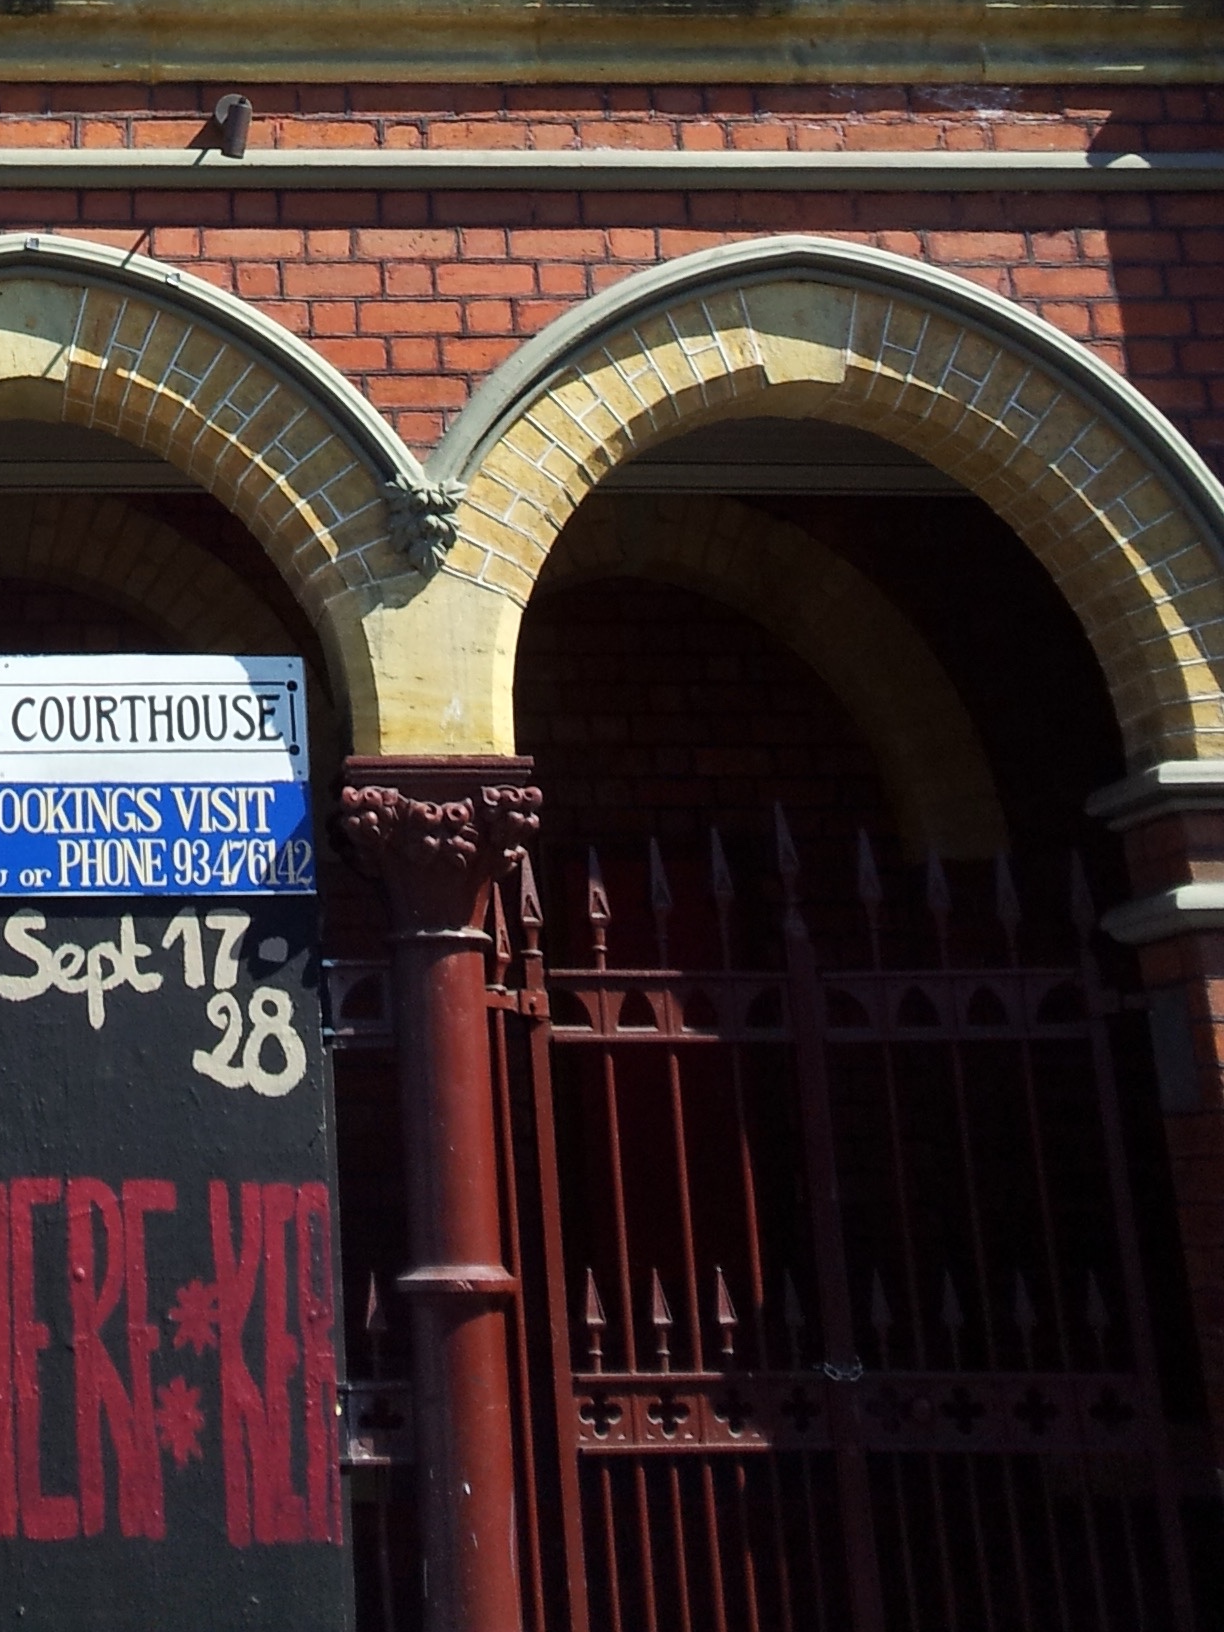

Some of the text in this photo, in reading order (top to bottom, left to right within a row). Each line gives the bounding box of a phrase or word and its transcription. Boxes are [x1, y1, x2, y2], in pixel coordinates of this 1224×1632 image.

[11, 694, 284, 743] COURTHOUSE
[170, 787, 275, 834] VISIT
[19, 868, 52, 887] or
[57, 838, 167, 887] PHONE
[192, 986, 307, 1098] 28
